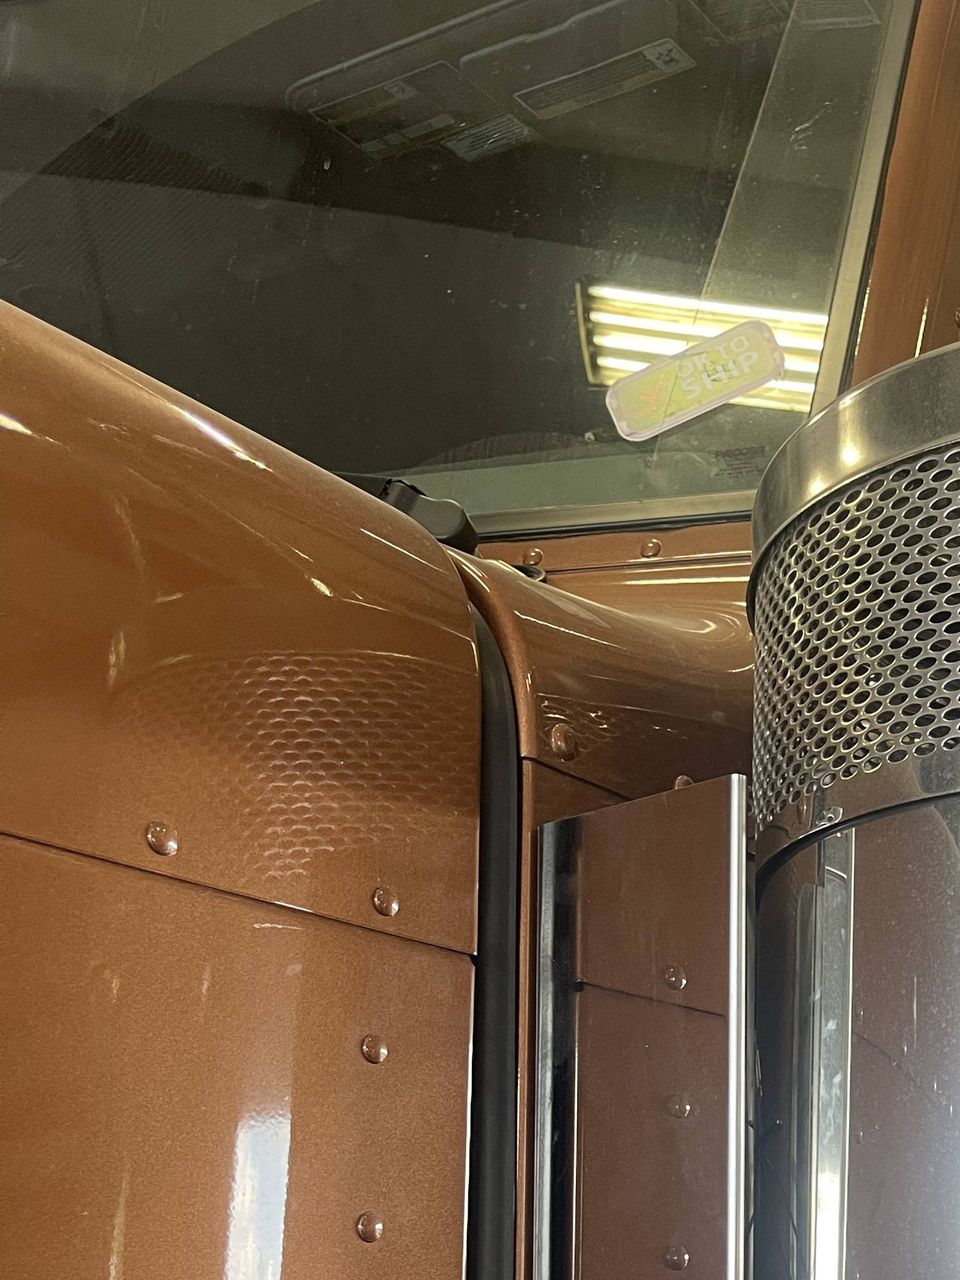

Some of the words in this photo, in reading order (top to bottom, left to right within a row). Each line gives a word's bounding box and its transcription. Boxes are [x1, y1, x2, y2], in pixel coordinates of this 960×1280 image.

[677, 352, 710, 377] OK
[715, 335, 749, 359] TO
[681, 352, 760, 400] SHIP
